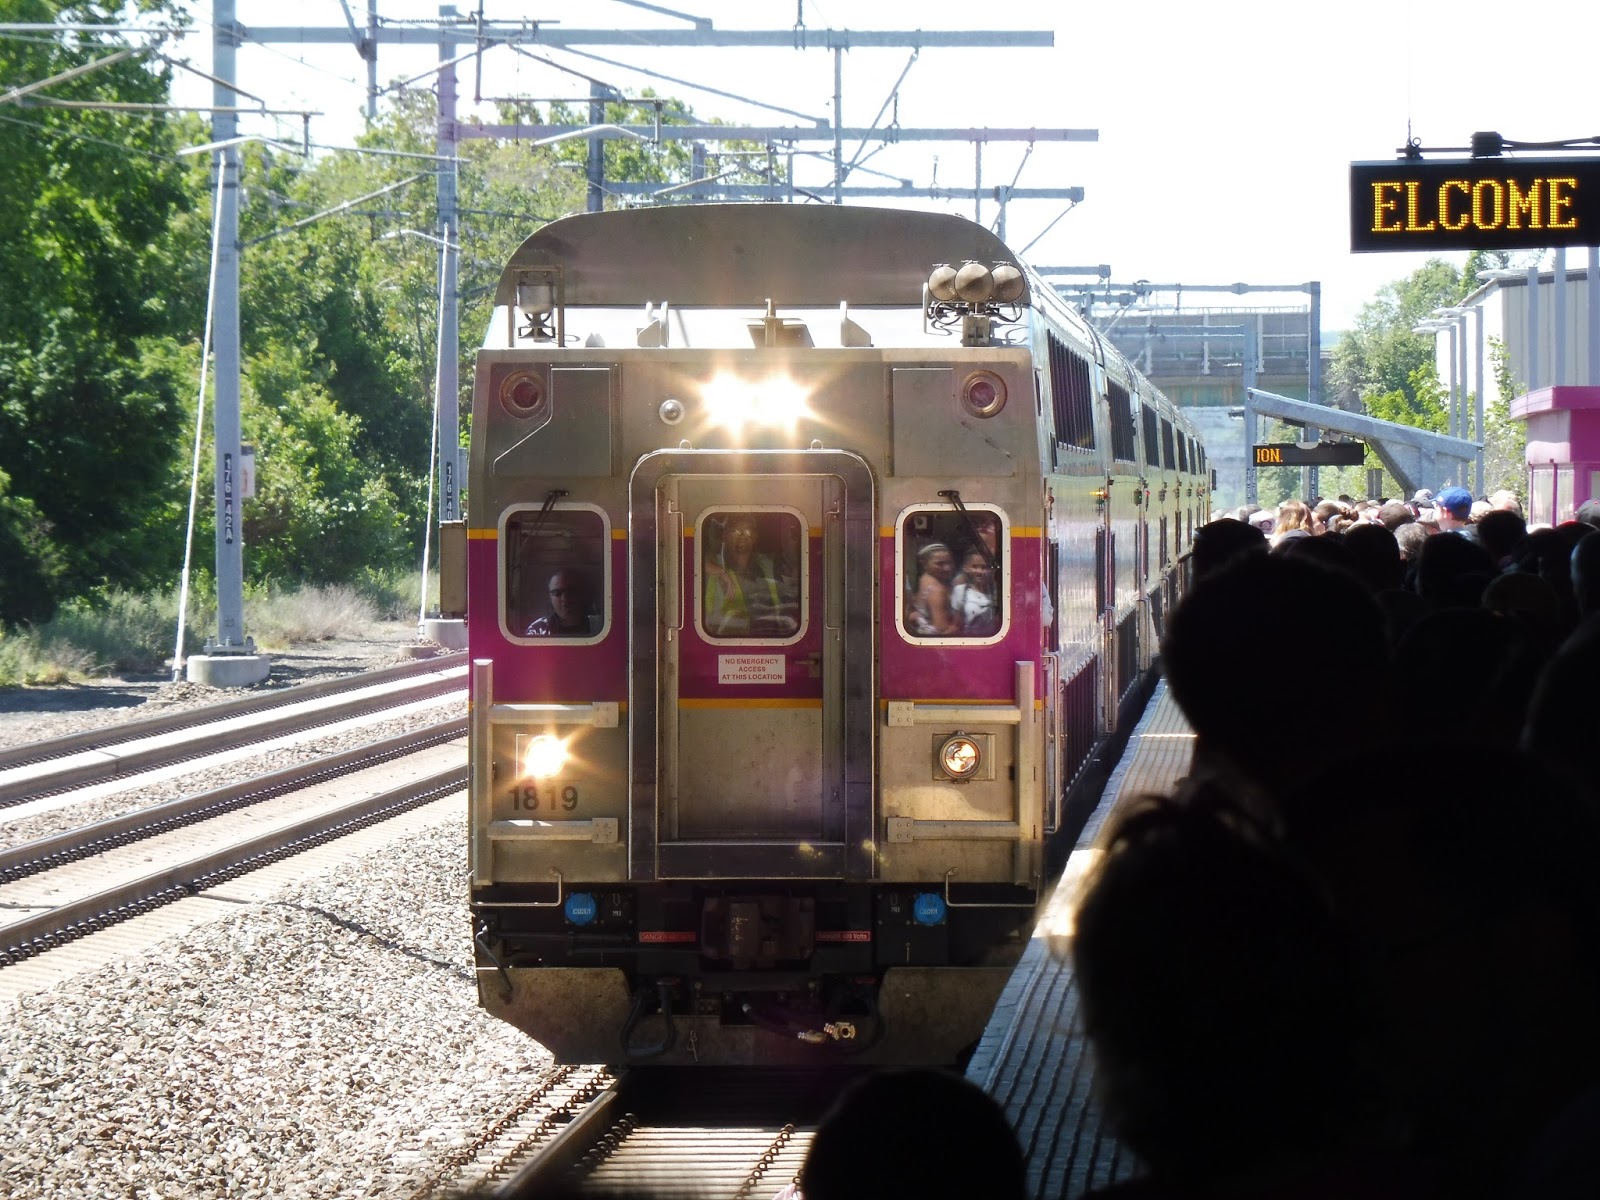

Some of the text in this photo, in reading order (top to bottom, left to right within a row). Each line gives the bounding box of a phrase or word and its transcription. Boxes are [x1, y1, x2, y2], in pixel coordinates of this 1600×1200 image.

[1371, 177, 1579, 232] ELCOME
[224, 458, 233, 540] 176-42A
[508, 785, 578, 811] 1819
